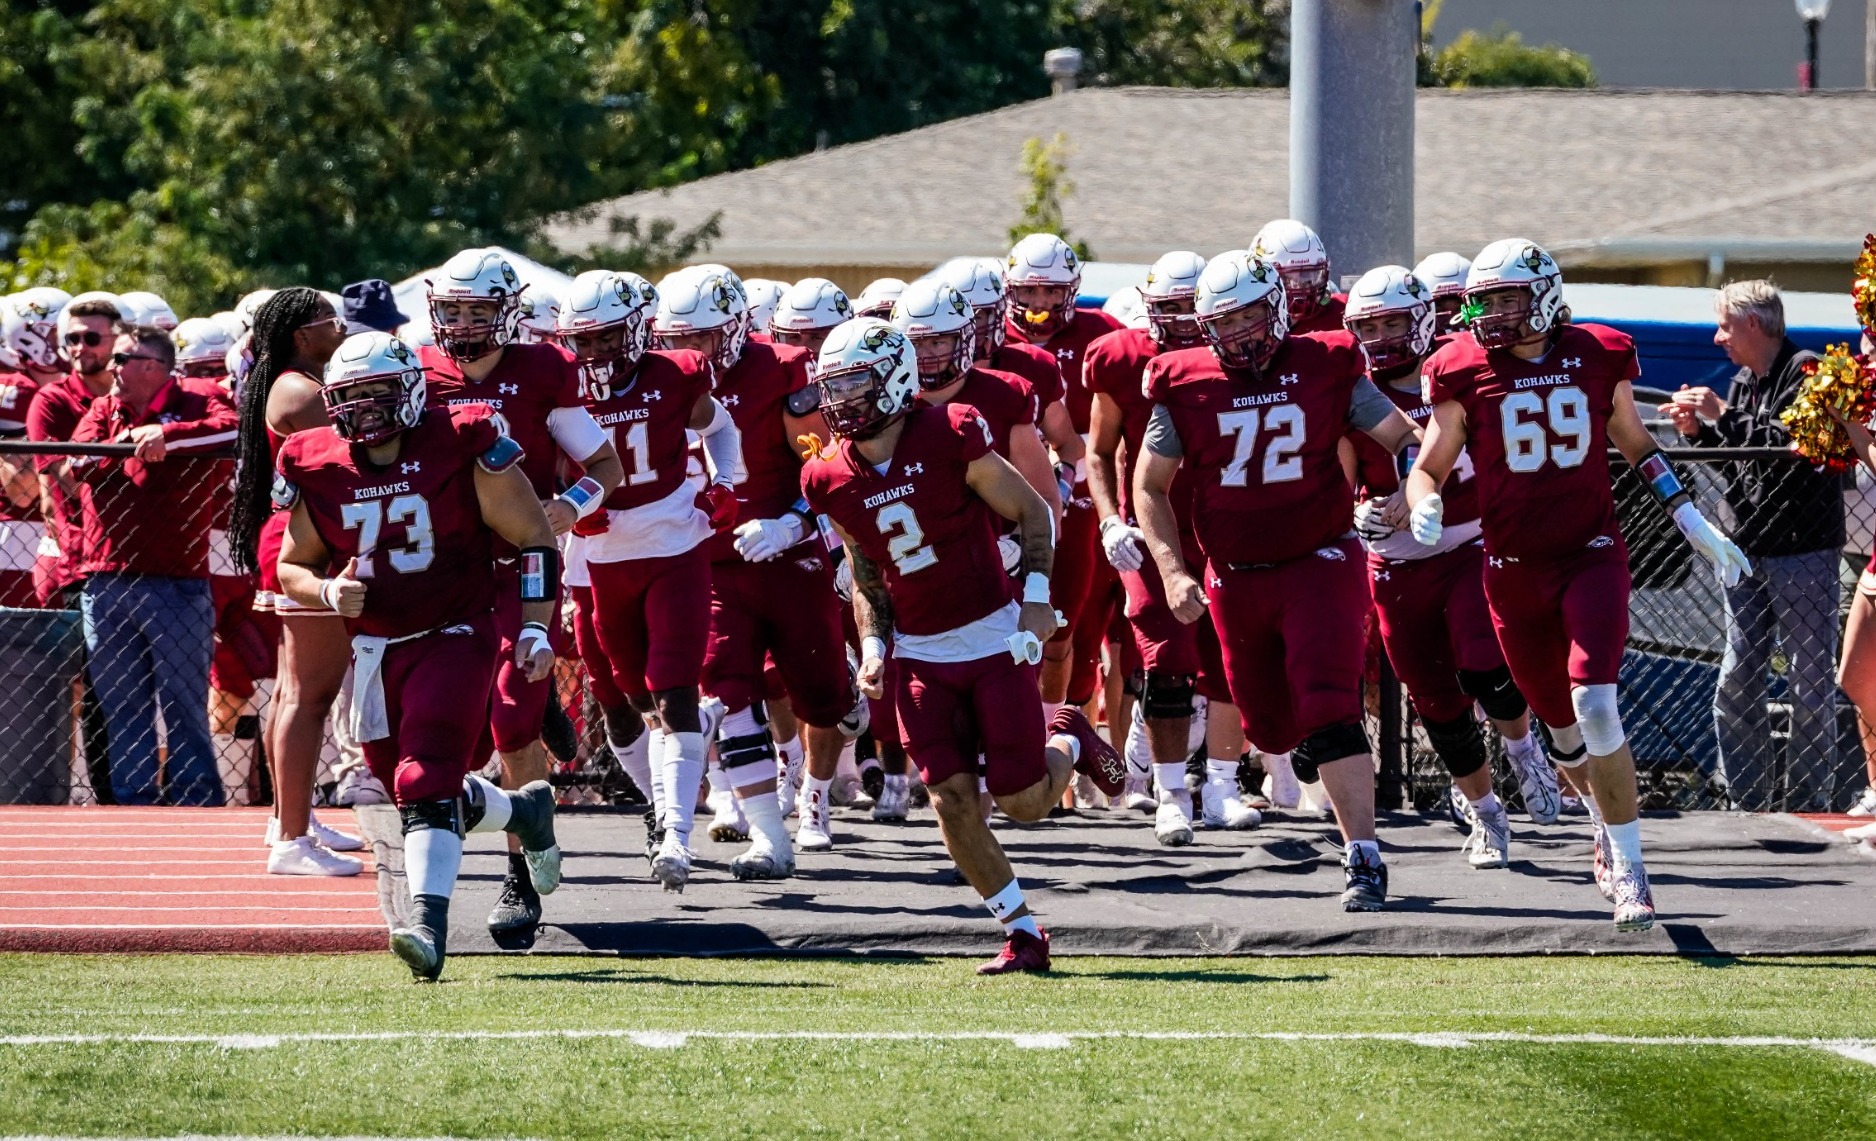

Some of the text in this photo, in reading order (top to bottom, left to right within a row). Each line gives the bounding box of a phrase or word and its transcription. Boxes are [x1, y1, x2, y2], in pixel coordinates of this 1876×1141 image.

[1232, 391, 1288, 408] KOHAWKS
[1514, 374, 1571, 389] KOHAWKS
[1216, 403, 1307, 487] 72
[1500, 385, 1592, 473] 69
[354, 481, 410, 500] KOHAWKS
[863, 483, 915, 510] KOHAWKS
[340, 493, 436, 579] 73
[875, 500, 940, 577] 2
